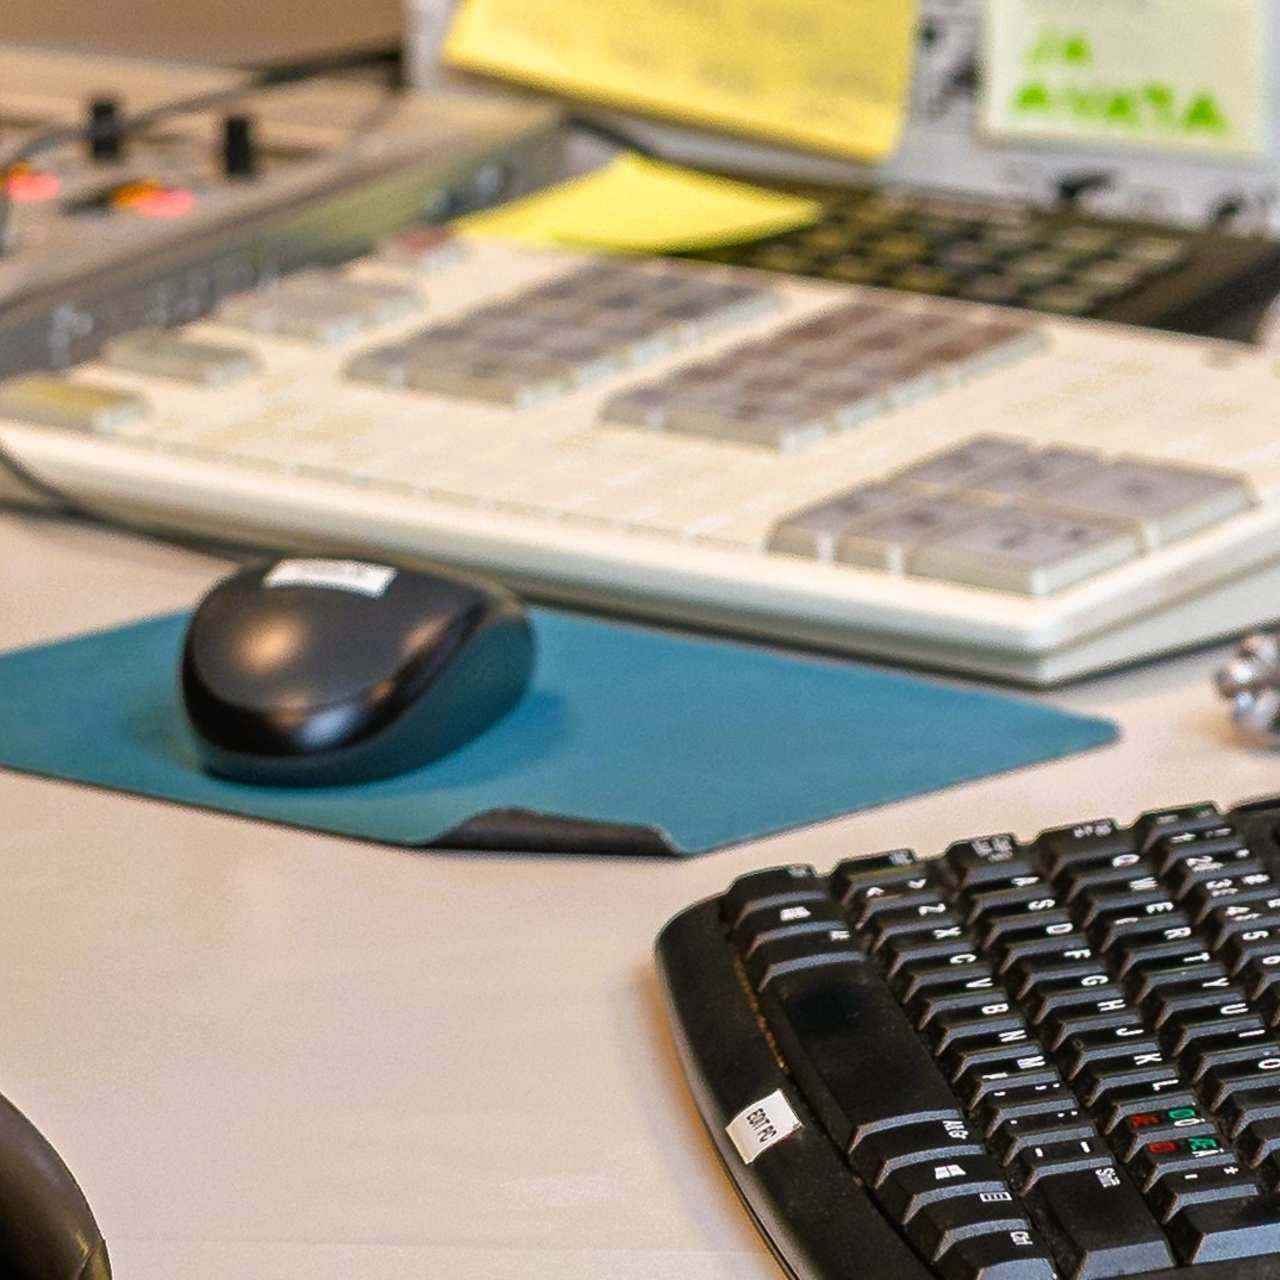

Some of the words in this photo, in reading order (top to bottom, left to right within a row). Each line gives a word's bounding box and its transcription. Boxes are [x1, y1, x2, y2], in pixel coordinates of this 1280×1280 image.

[1111, 853, 1140, 868] Q
[1011, 876, 1039, 886] A
[1129, 876, 1158, 891] W
[1028, 899, 1056, 911] S
[1145, 902, 1174, 914] E
[933, 926, 962, 939] X
[1046, 923, 1073, 934] D
[1164, 926, 1192, 940] R
[1242, 930, 1270, 940] 5
[950, 953, 977, 964] C
[1064, 948, 1091, 959] F
[1183, 952, 1210, 962] T
[965, 977, 994, 988] V
[1081, 975, 1109, 986] G
[1202, 977, 1230, 988] Y
[981, 1003, 1009, 1015] B
[1097, 999, 1126, 1011] H
[1220, 1003, 1249, 1014] U
[998, 1029, 1027, 1042] N
[1115, 1027, 1144, 1036] J
[1238, 1029, 1266, 1038] I
[1017, 1055, 1046, 1069] M
[1133, 1053, 1163, 1065] K
[1152, 1079, 1179, 1091] L
[746, 1107, 771, 1130] EDIT
